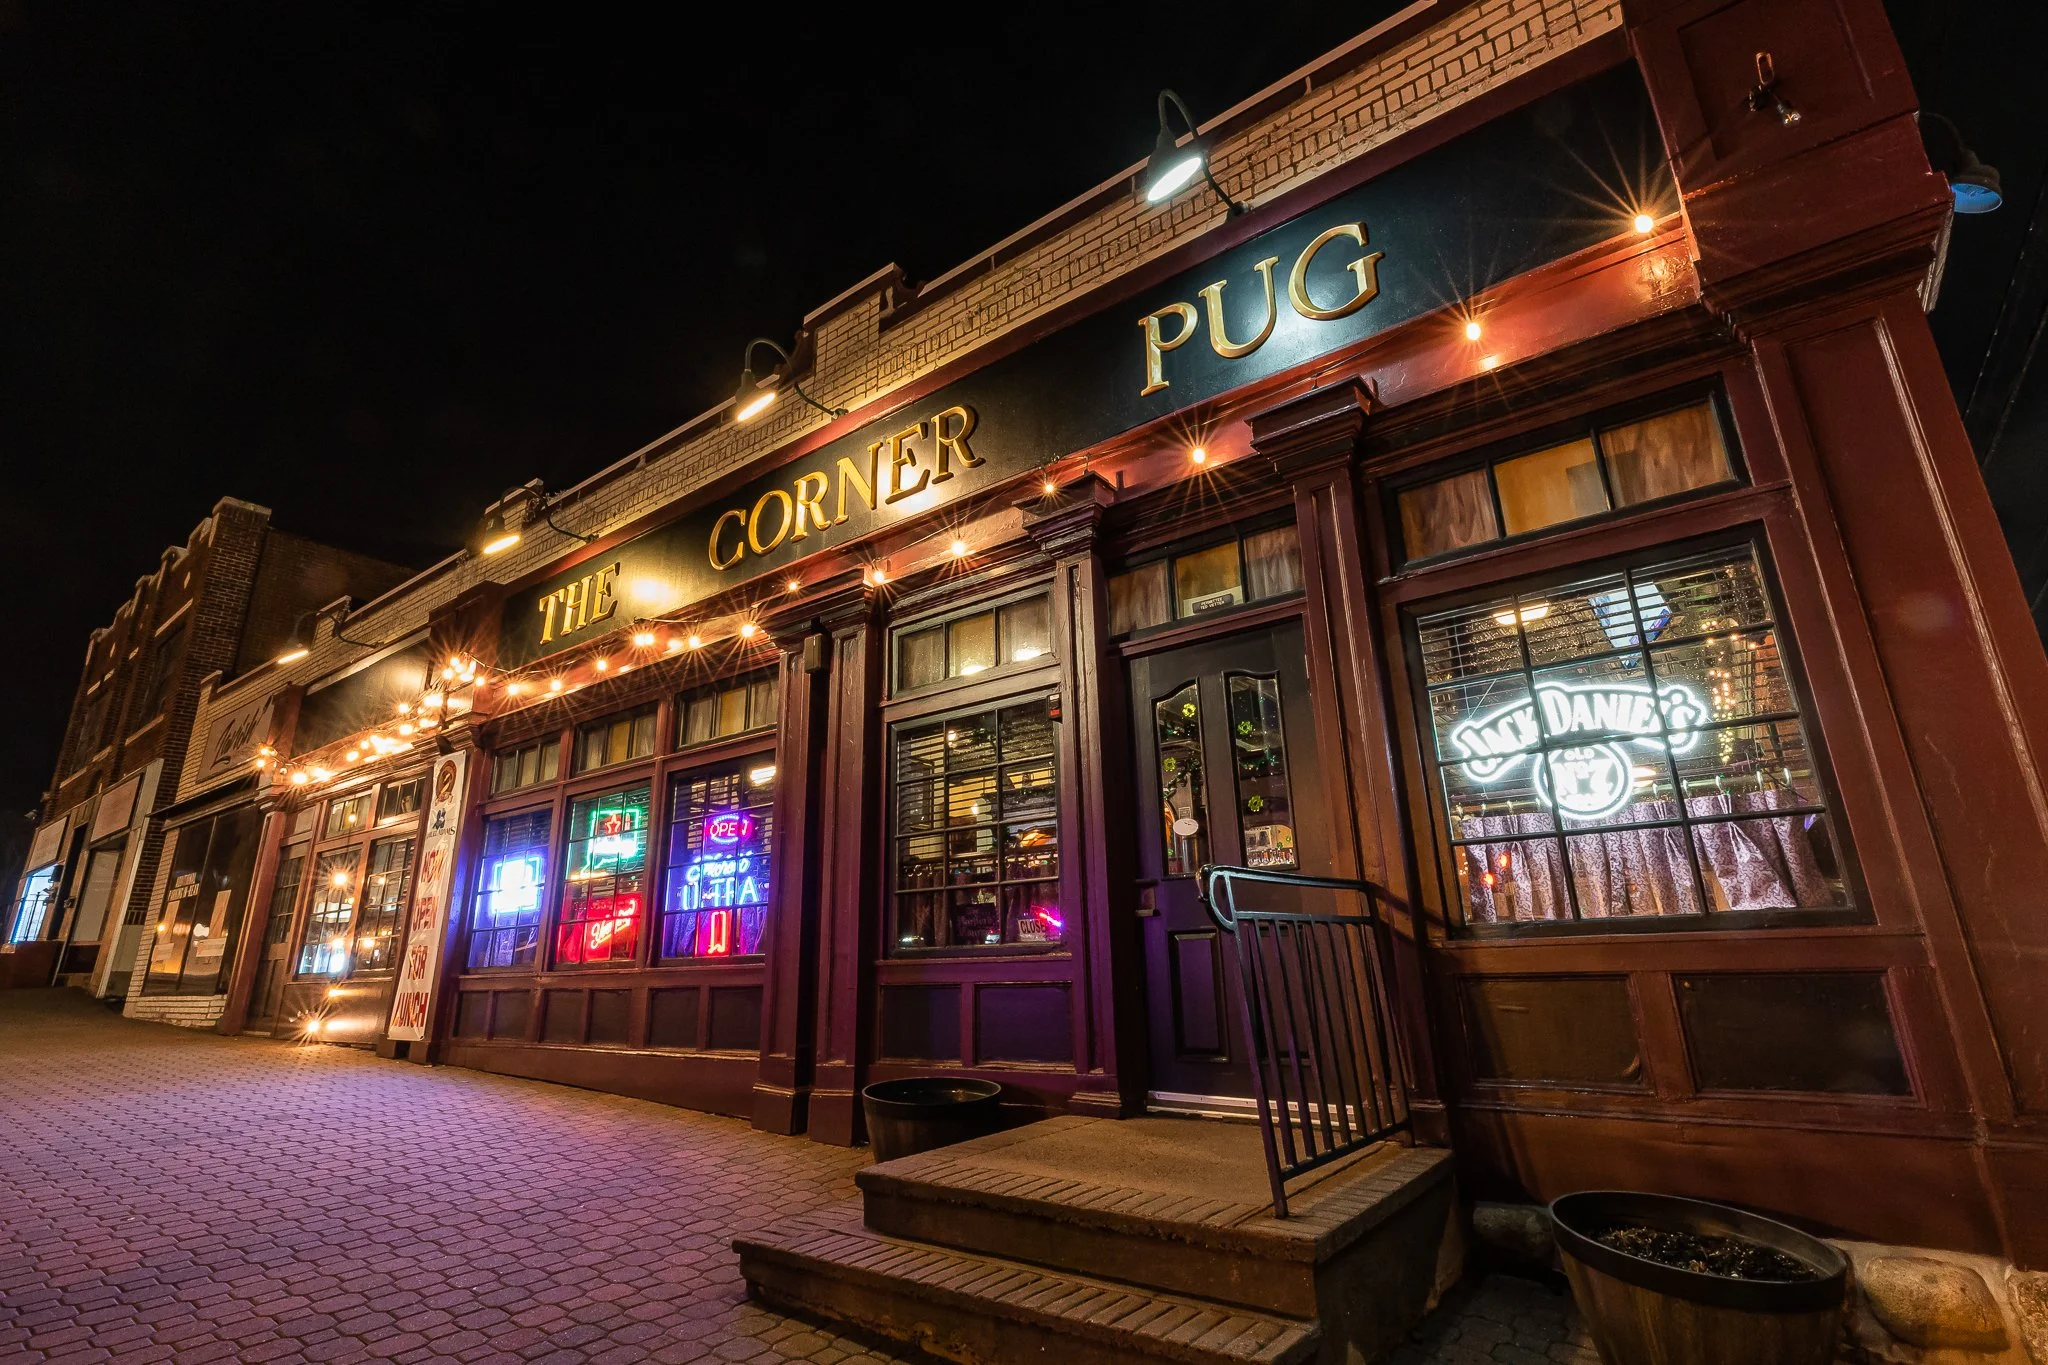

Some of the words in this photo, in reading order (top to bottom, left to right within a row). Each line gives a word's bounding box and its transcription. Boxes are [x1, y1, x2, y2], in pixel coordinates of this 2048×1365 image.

[539, 562, 620, 645] THE
[708, 404, 986, 571] CORNER
[1138, 221, 1385, 397] PUG
[1461, 706, 1538, 773] JACK
[1563, 749, 1594, 761] OLD
[420, 849, 446, 883] NOW
[411, 896, 440, 931] OPEN
[408, 945, 428, 980] FOR
[392, 992, 429, 1027] LUNCH
